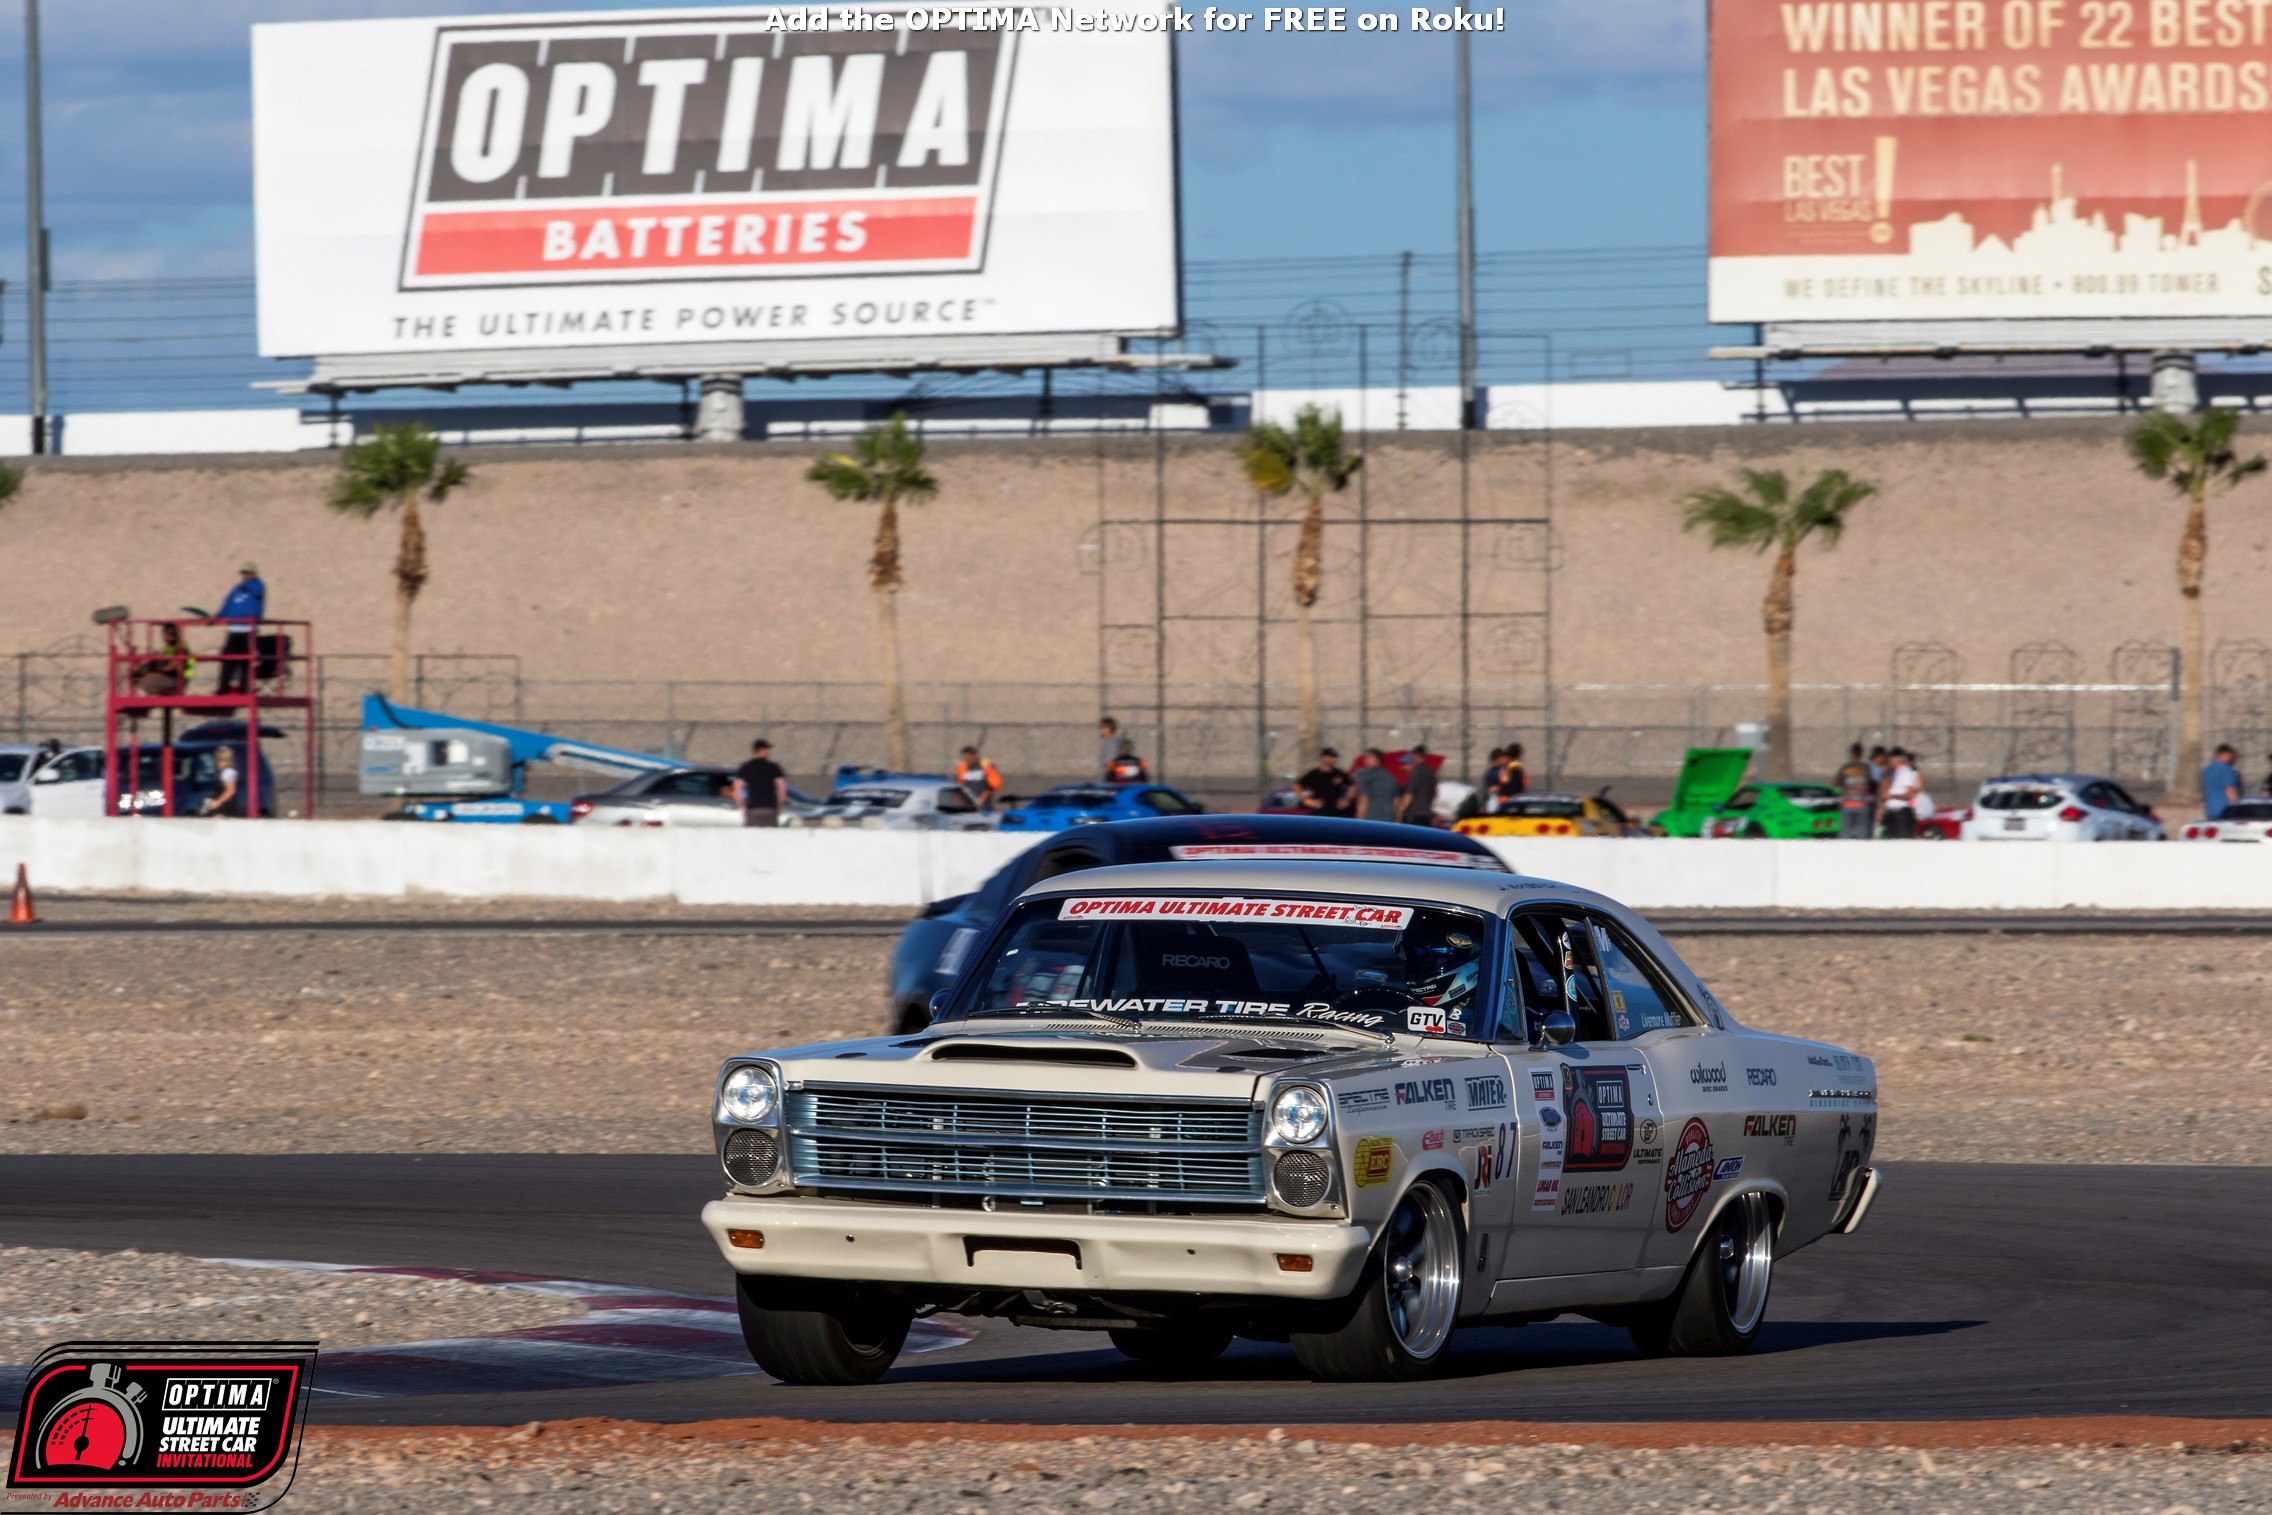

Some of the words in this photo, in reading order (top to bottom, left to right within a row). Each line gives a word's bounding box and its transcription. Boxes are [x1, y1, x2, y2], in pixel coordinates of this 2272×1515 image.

[1780, 2, 1988, 52] WINNER
[2001, 1, 2066, 50] OF
[2078, 0, 2134, 49] 22
[2149, 0, 2271, 48] BEST
[1782, 66, 1873, 118] LAS
[1885, 64, 2043, 116] VEGAS
[2058, 61, 2269, 113] AWARDS
[448, 50, 971, 185] OPTIMA
[1783, 153, 1867, 199] BEST
[541, 210, 868, 263] BATTERIES
[1783, 278, 1815, 298] WE
[1823, 277, 1899, 297] DEFINE
[1909, 276, 1946, 296] THE
[1956, 274, 2043, 295] SKYLINE
[394, 315, 457, 338] THE
[479, 308, 655, 336] ULTIMATE
[675, 304, 808, 330] POWER
[1069, 901, 1155, 915] OPTIMA
[1158, 901, 1270, 917] ULTIMATE
[1272, 904, 1356, 920] STREET
[1355, 907, 1404, 924] CAR
[1162, 953, 1231, 970] RECARO
[1215, 1000, 1290, 1016] TIRE
[1296, 1002, 1385, 1027] Racing
[1410, 1012, 1444, 1027] GTV
[1746, 1068, 1777, 1087] RECARO
[1394, 1078, 1456, 1106] FALKEN
[1598, 1085, 1623, 1104] OPTIMA
[1600, 1111, 1627, 1127] ULTIMATE
[1743, 1114, 1797, 1137] FALKEN
[1601, 1127, 1617, 1141] STREET
[1616, 1127, 1627, 1140] CAR
[1494, 1121, 1518, 1180] 87
[1633, 1149, 1662, 1158] ULTIMATE
[1669, 1139, 1713, 1177] Alameda
[1668, 1172, 1707, 1202] Collision
